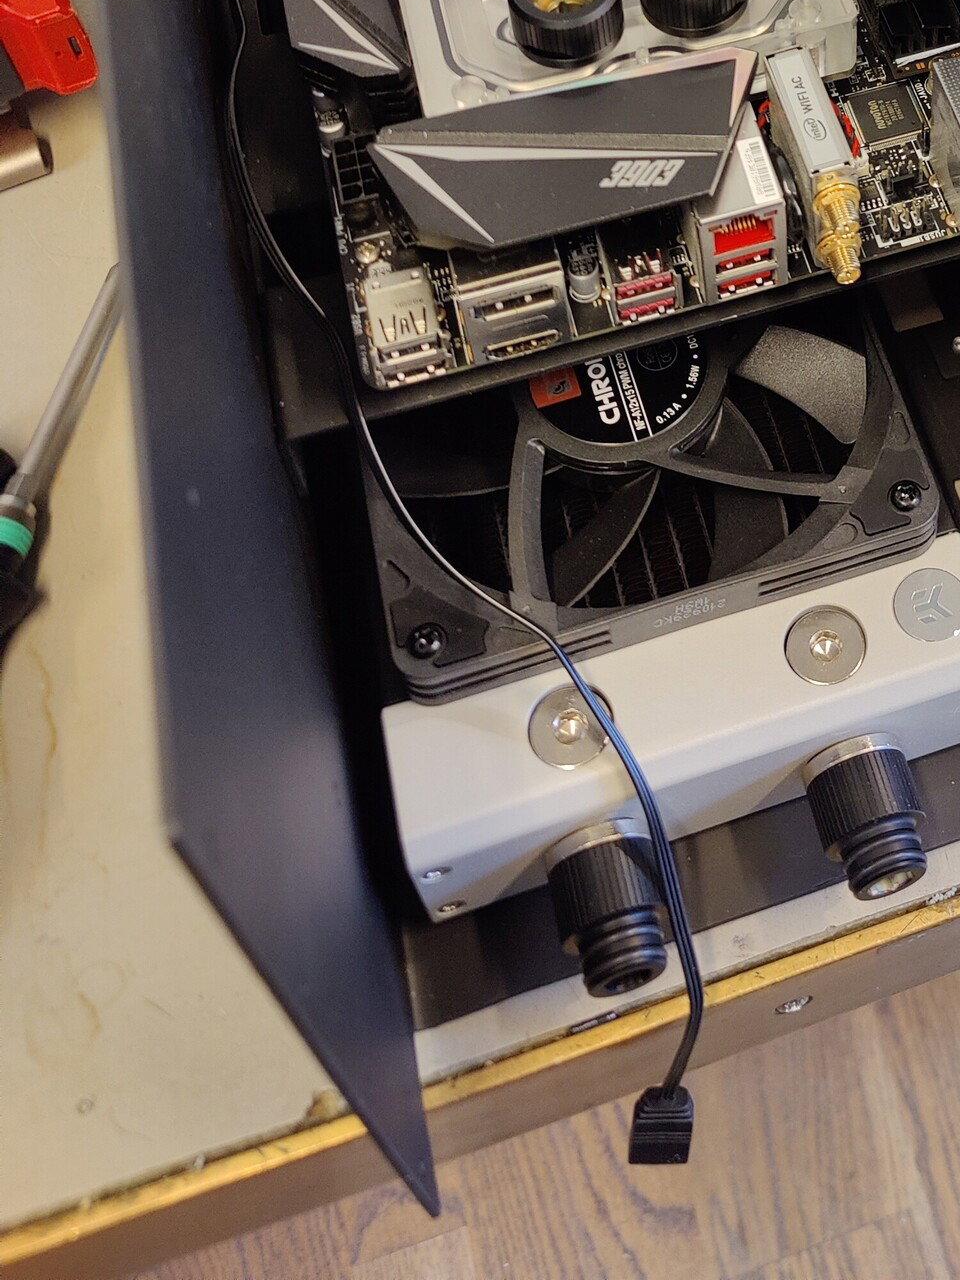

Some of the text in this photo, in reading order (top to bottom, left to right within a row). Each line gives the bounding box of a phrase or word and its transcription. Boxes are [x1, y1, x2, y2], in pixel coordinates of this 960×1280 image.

[791, 76, 806, 90] AC
[796, 90, 813, 115] WIFI
[598, 159, 686, 189] EDGE
[584, 357, 621, 425] CHRO
[655, 408, 676, 424] 0.13
